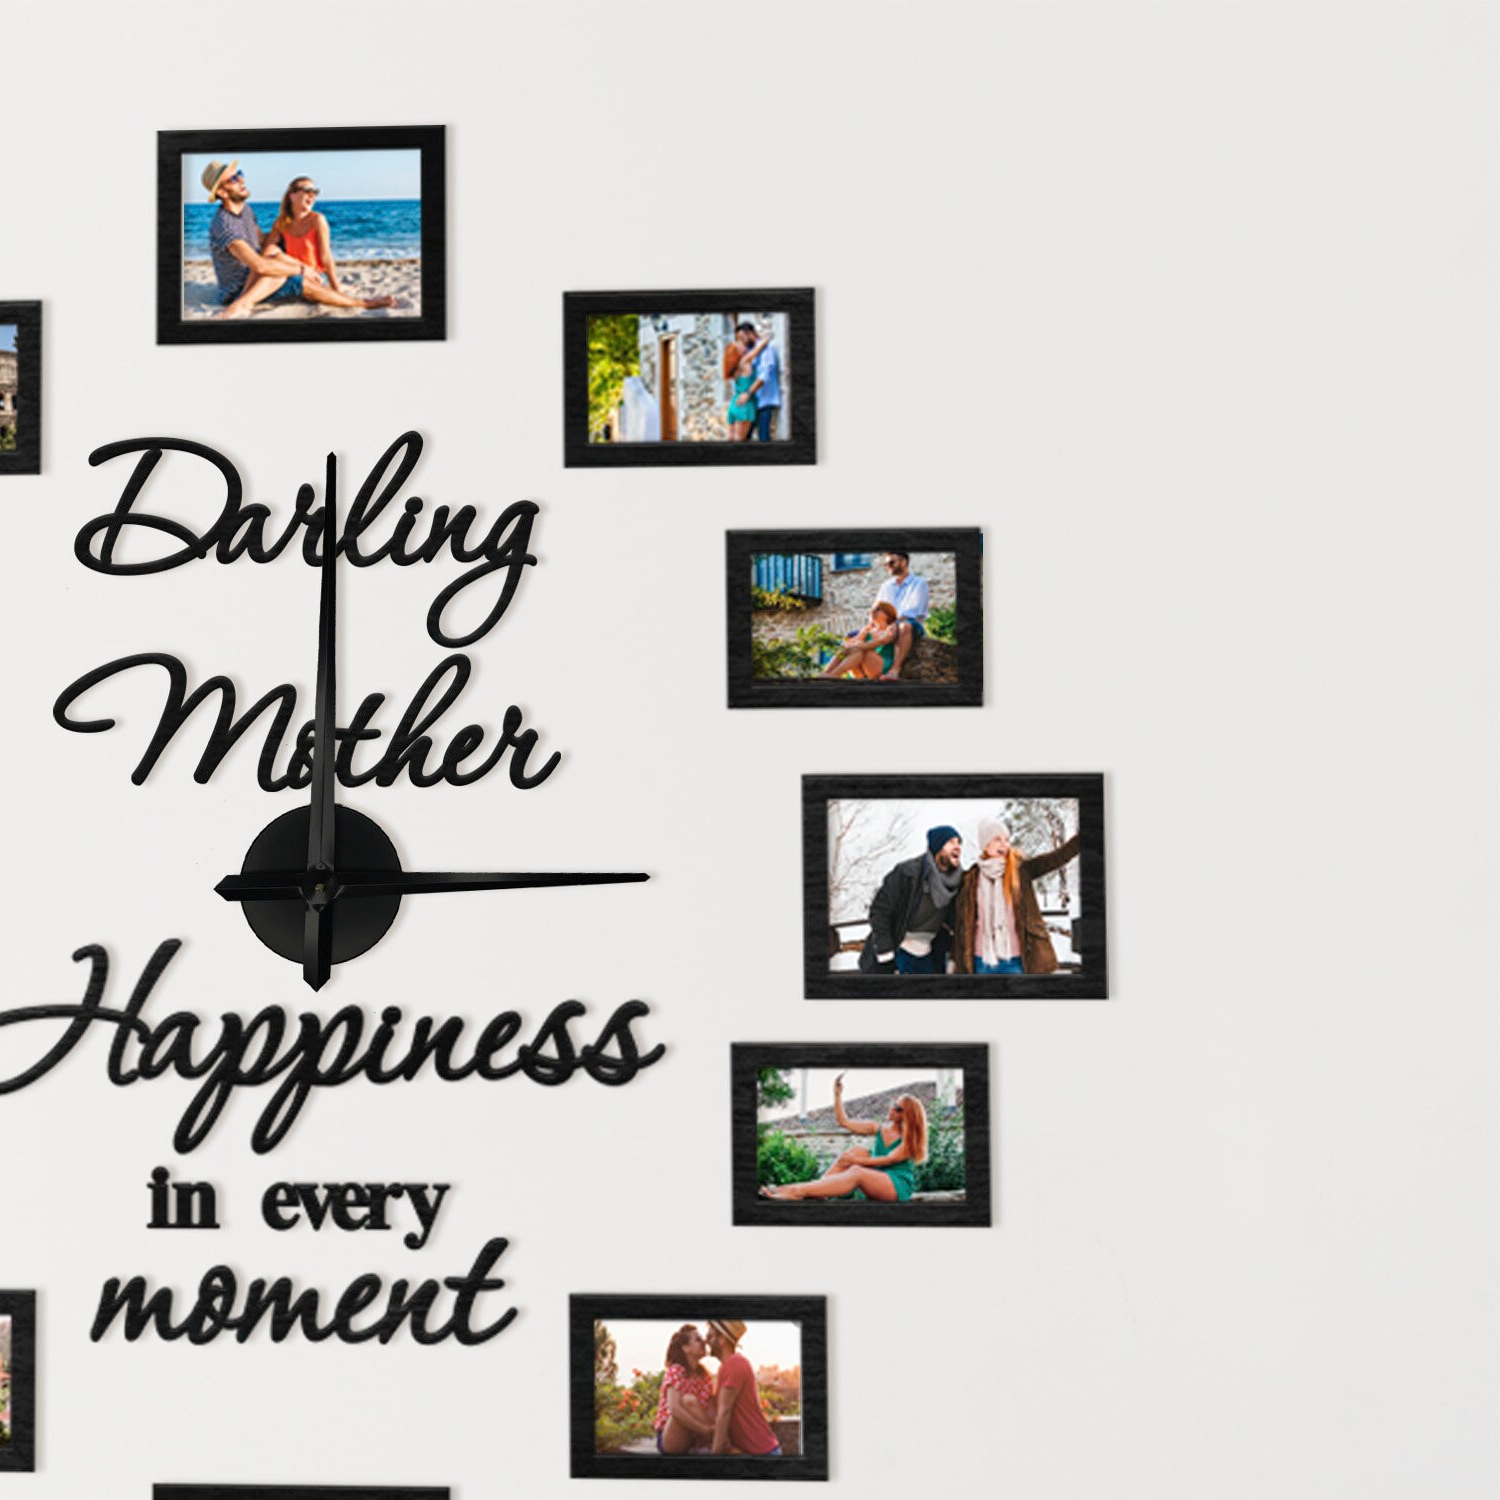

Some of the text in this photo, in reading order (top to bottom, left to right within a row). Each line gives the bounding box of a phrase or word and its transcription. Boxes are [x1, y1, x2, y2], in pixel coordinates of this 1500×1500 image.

[73, 430, 542, 649] Darling
[146, 1166, 451, 1250] in every
[90, 1237, 519, 1346] moment
